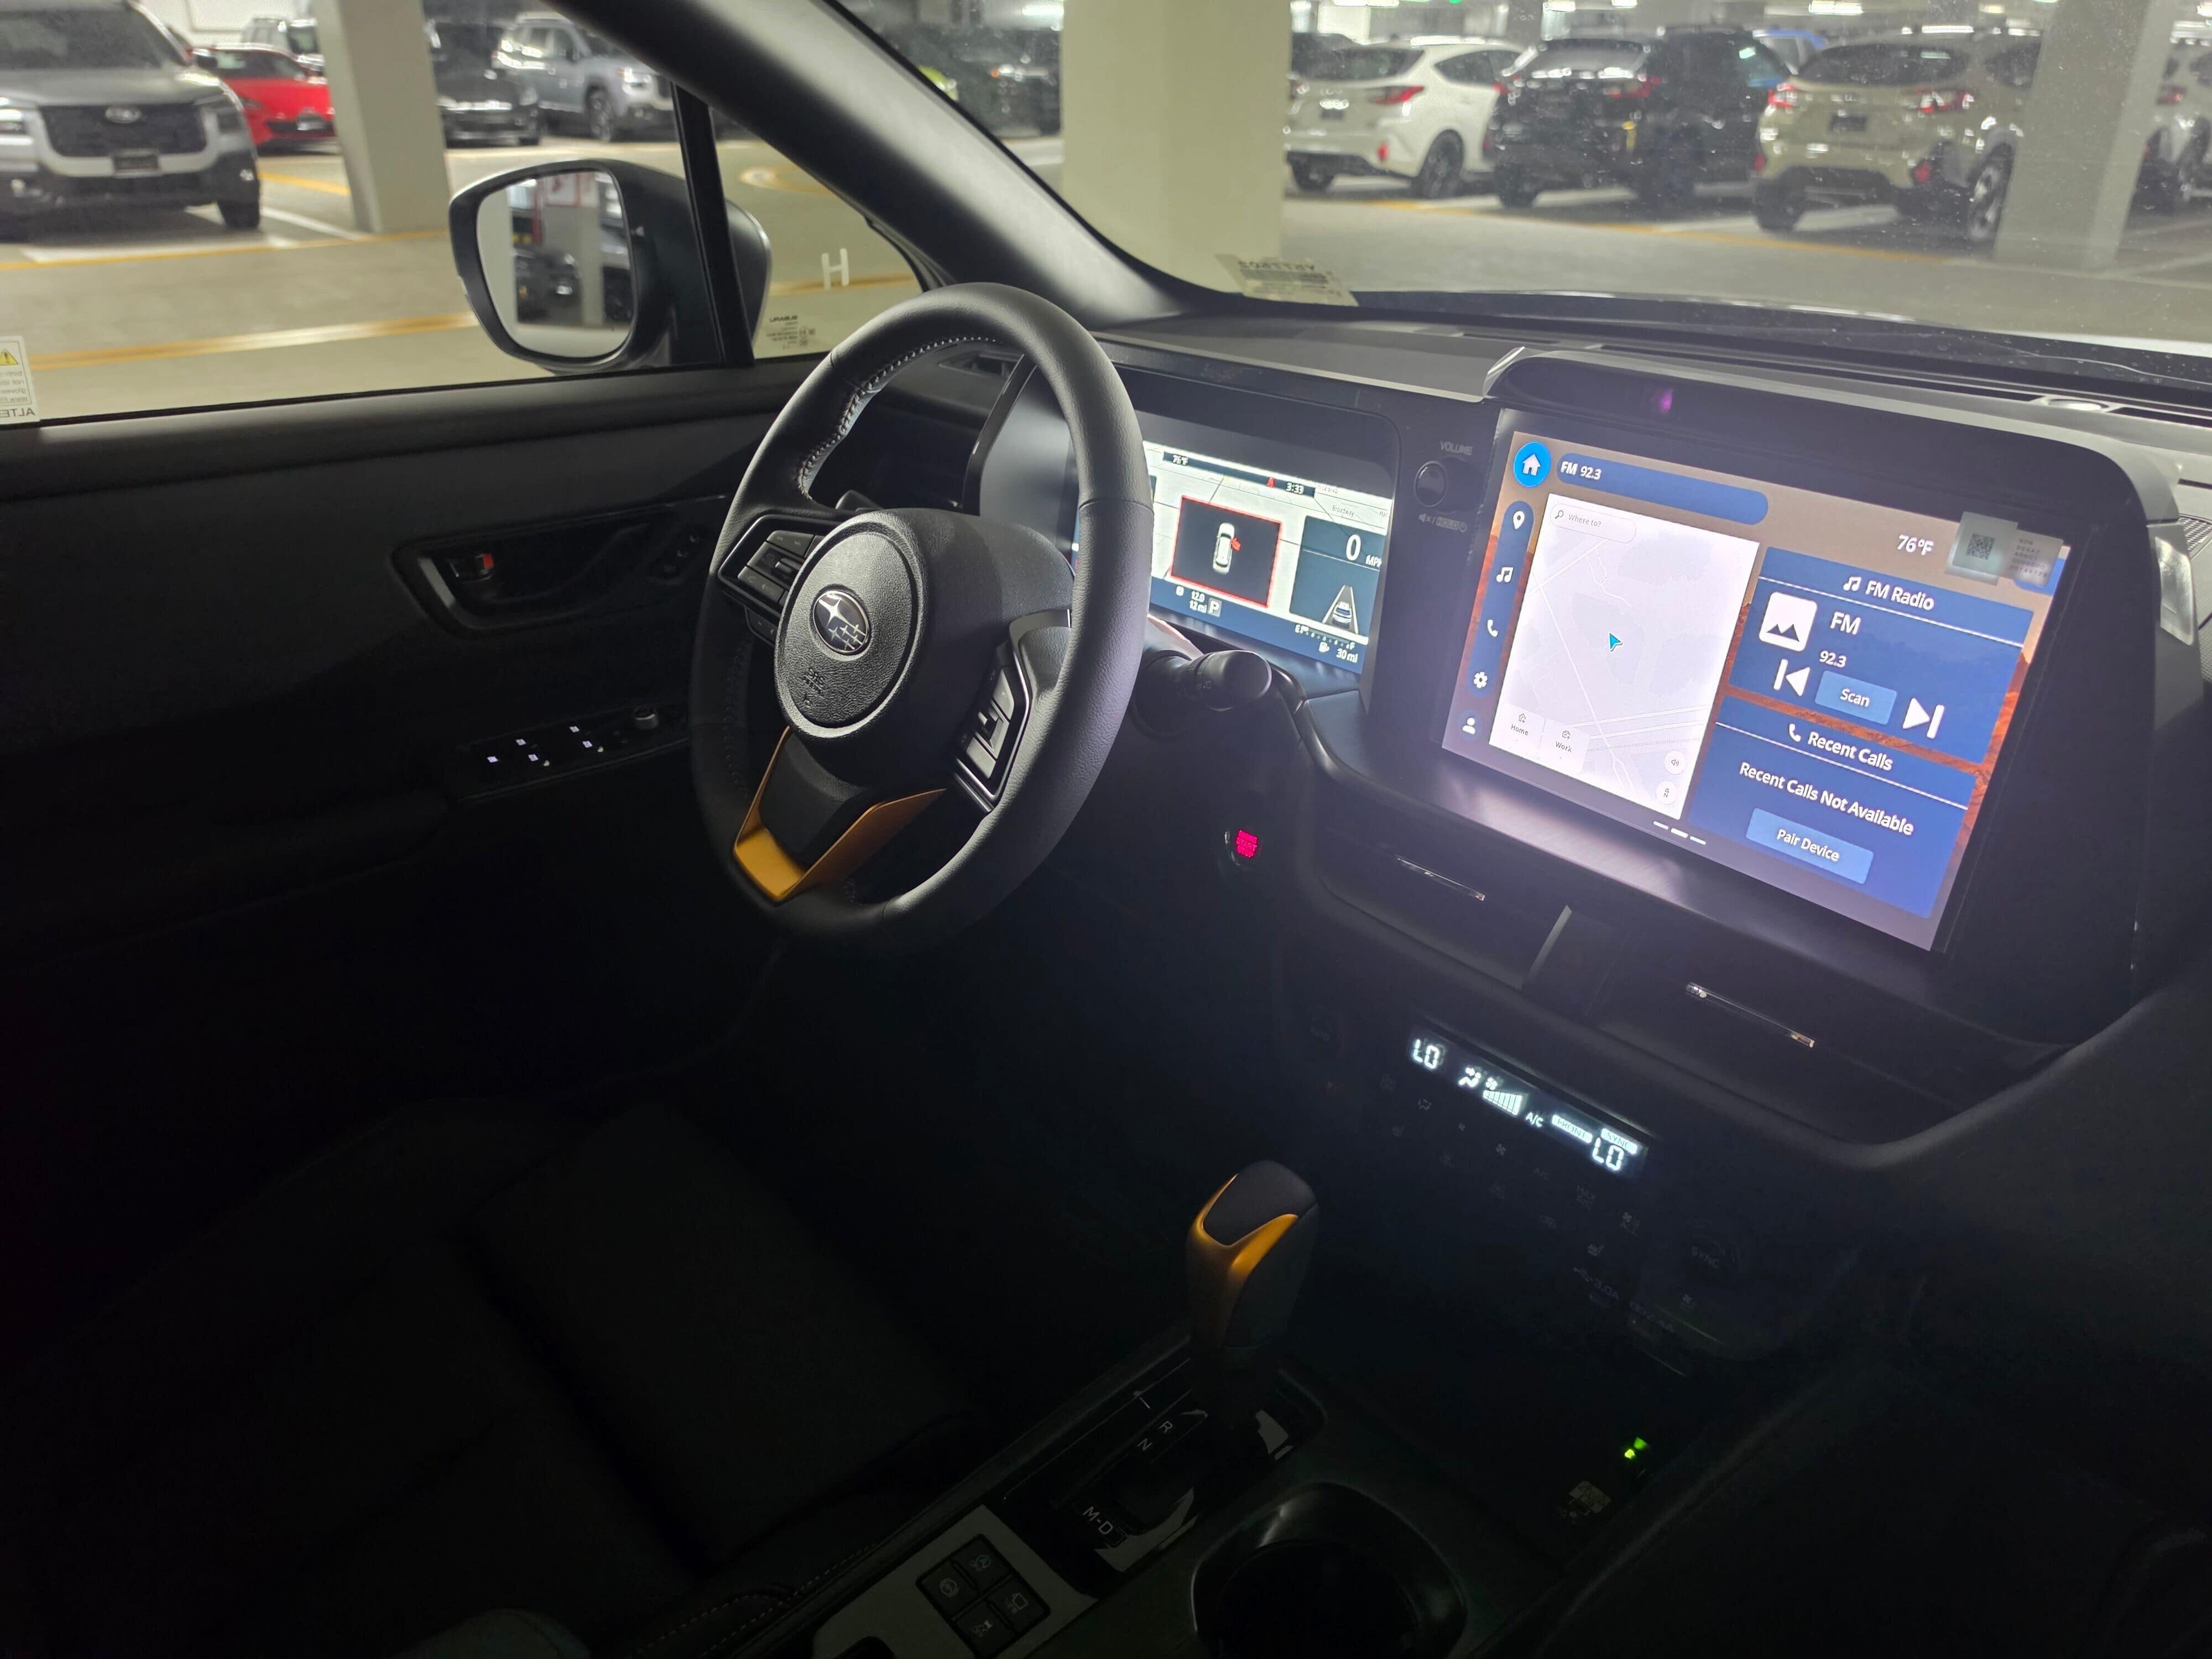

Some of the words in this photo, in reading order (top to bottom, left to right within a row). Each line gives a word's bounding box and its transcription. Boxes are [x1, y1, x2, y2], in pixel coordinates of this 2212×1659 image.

[1440, 441, 1473, 456] VOLUME
[1561, 461, 1578, 476] FM
[1580, 466, 1602, 481] 92.3
[1286, 482, 1305, 494] 3:33
[1332, 505, 1355, 518] Broadway
[1568, 513, 1589, 525] Where
[1591, 519, 1601, 528] to?
[1345, 534, 1361, 561] 0
[1897, 534, 1934, 556] 76°F
[1865, 580, 1890, 599] FM
[1891, 587, 1935, 611] Radio
[1208, 600, 1220, 613] P
[1830, 611, 1861, 635] FM
[1336, 648, 1347, 660] 30
[1819, 650, 1847, 668] 92.3
[1840, 688, 1870, 708] Scan
[1510, 723, 1529, 736] Home
[1555, 740, 1573, 753] Work
[1807, 731, 1858, 760] Recent
[1858, 748, 1893, 771] Calls
[1739, 761, 1786, 790] Recent
[1786, 779, 1819, 801] Calls
[1820, 790, 1848, 812] Not
[1848, 801, 1914, 836] Available
[1777, 828, 1801, 846] Pair
[1801, 837, 1840, 863] Device
[1525, 1111, 1544, 1128] A/C
[1557, 1118, 1587, 1139] FRONT
[1606, 1131, 1631, 1150] SYNC
[1159, 1420, 1173, 1433] R
[1136, 1438, 1153, 1452] N
